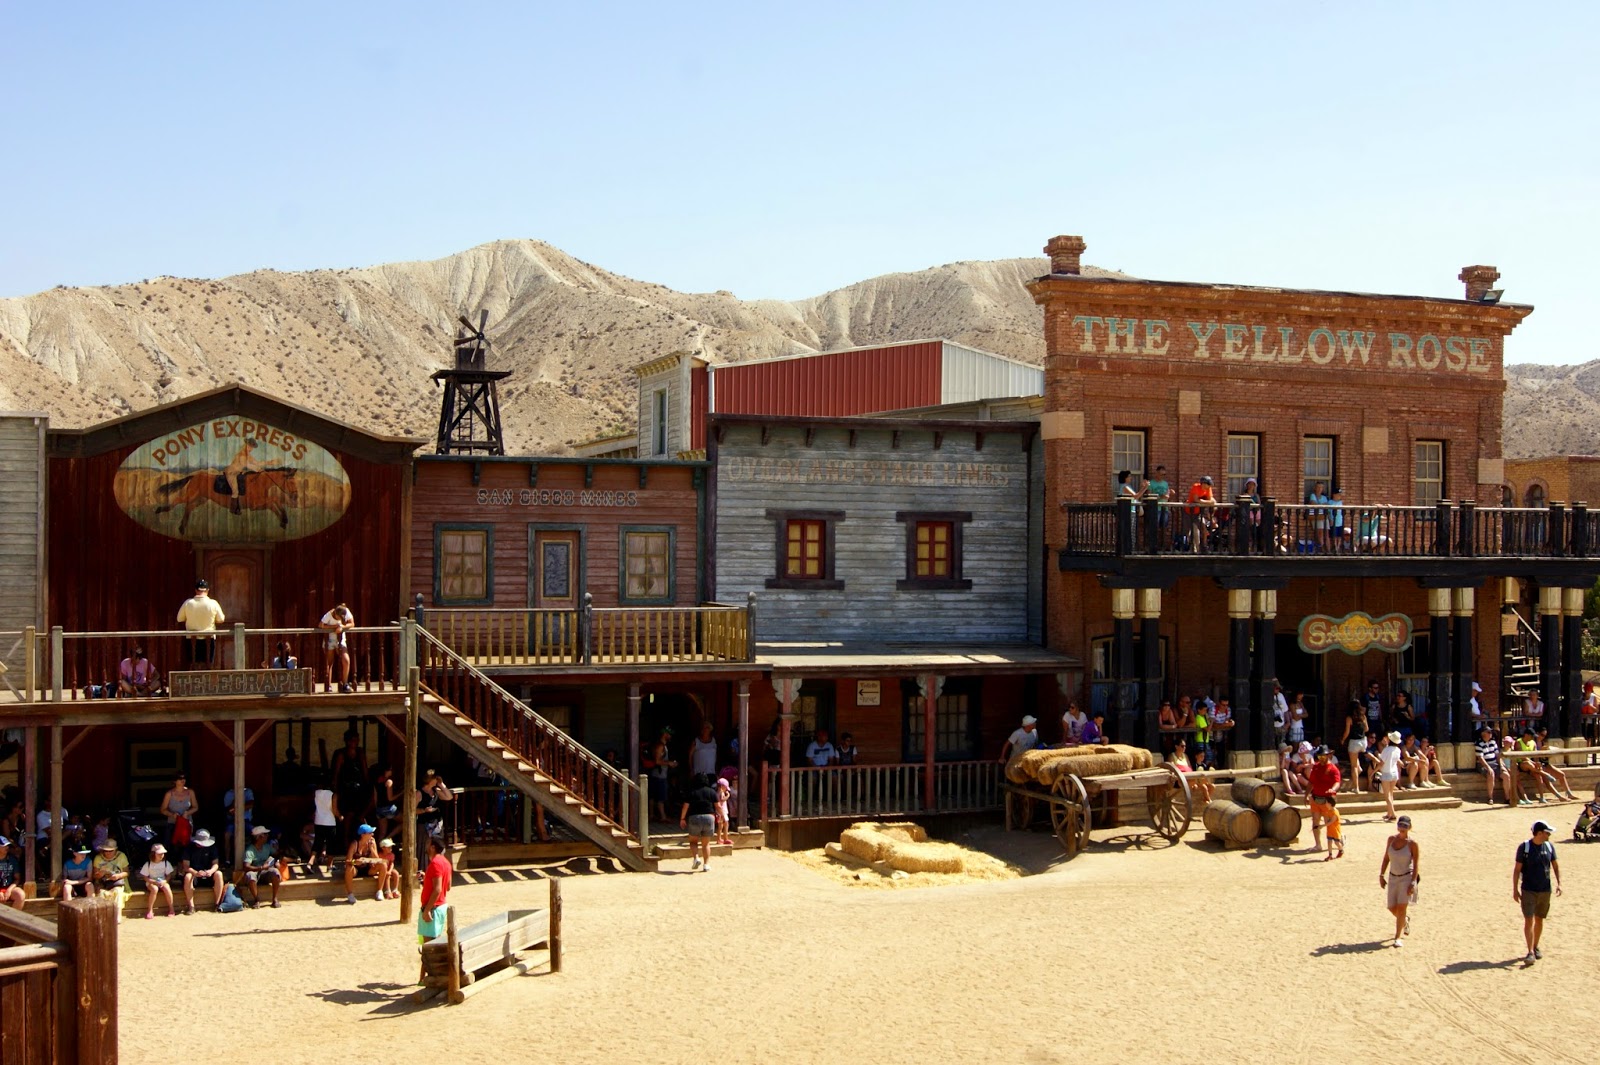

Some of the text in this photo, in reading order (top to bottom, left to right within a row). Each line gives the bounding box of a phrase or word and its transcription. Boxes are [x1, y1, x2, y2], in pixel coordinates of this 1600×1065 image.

[1072, 315, 1493, 373] THE YELLOW ROSE
[152, 420, 308, 466] PONY EXPRESS
[728, 456, 1009, 486] OVERLAND STAGE LINES
[477, 488, 638, 506] SAN DIEGO MINES
[1309, 620, 1401, 646] SALOON
[175, 671, 305, 697] TELEGRAPH
